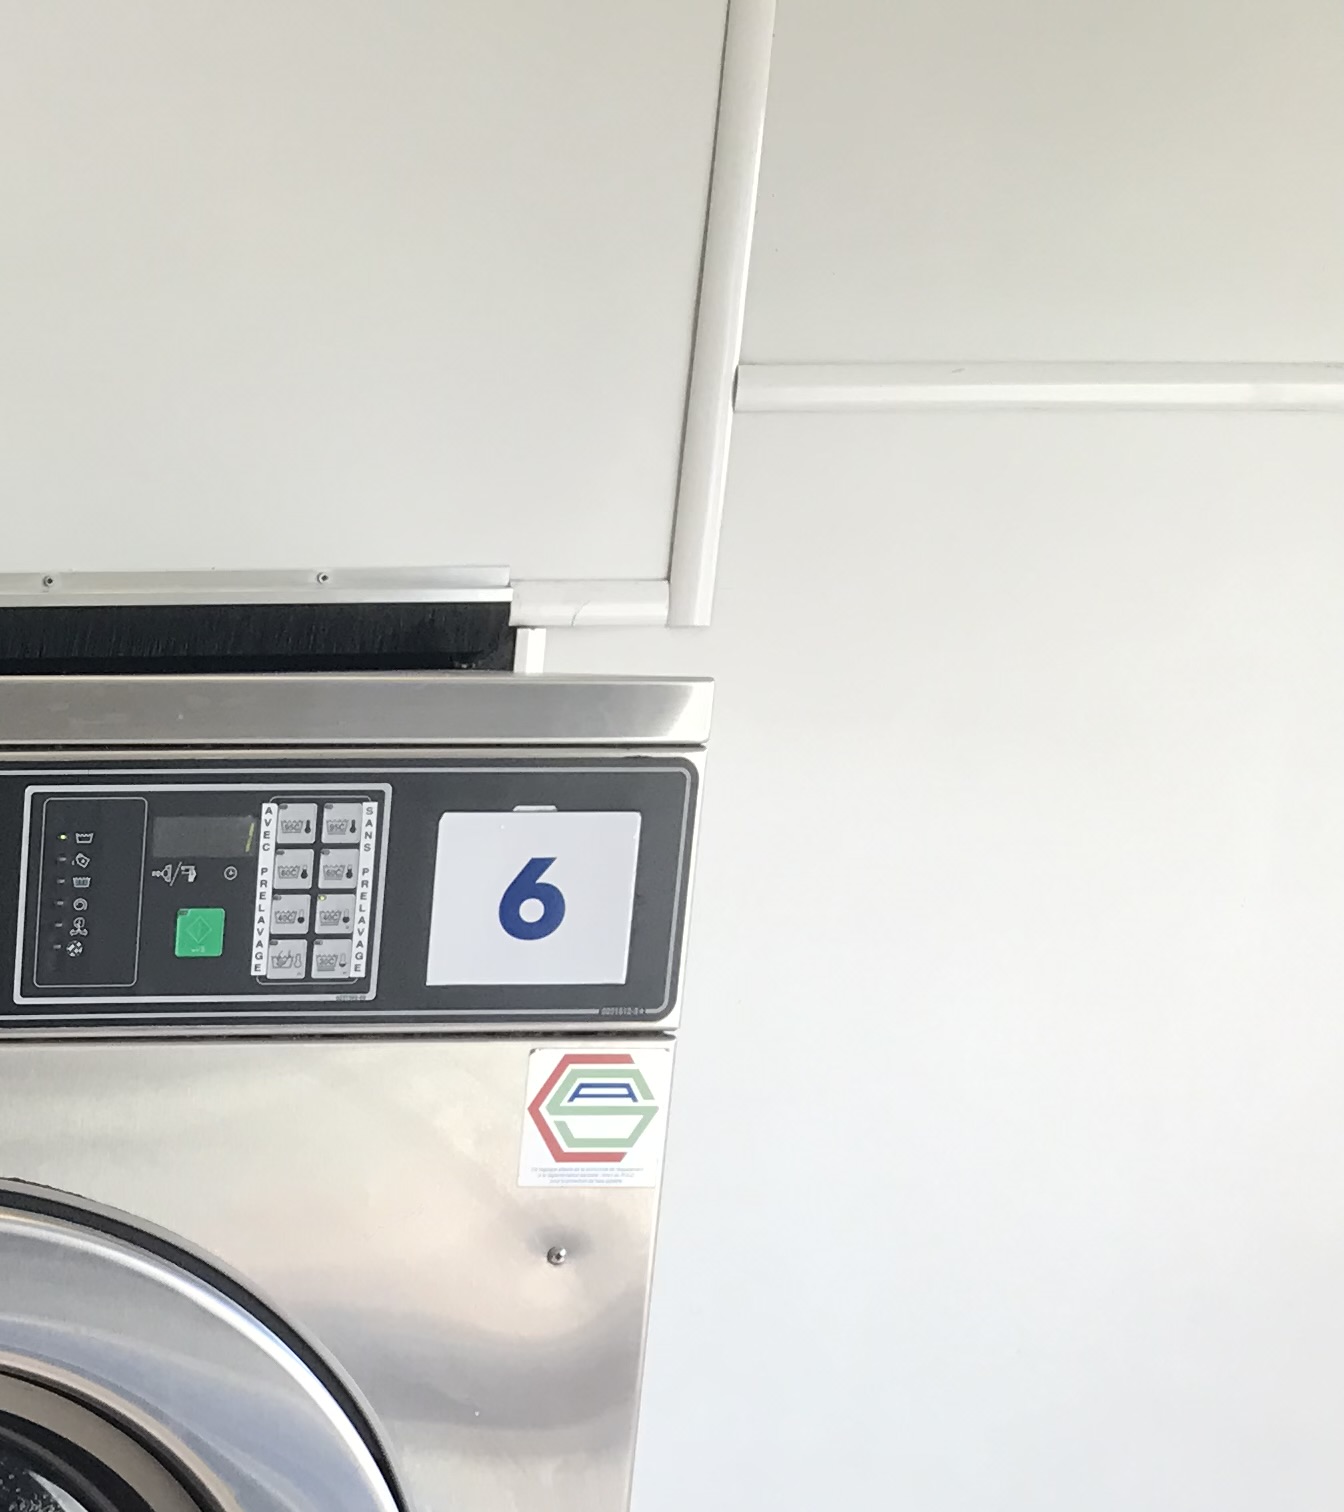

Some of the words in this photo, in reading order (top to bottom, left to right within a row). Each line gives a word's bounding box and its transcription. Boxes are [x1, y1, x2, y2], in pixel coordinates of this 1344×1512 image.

[263, 807, 273, 852] AVEC
[363, 807, 374, 852] SANS
[254, 867, 269, 972] PRELAVAGE
[354, 867, 370, 973] PRELAVAGE
[498, 857, 566, 941] 6
